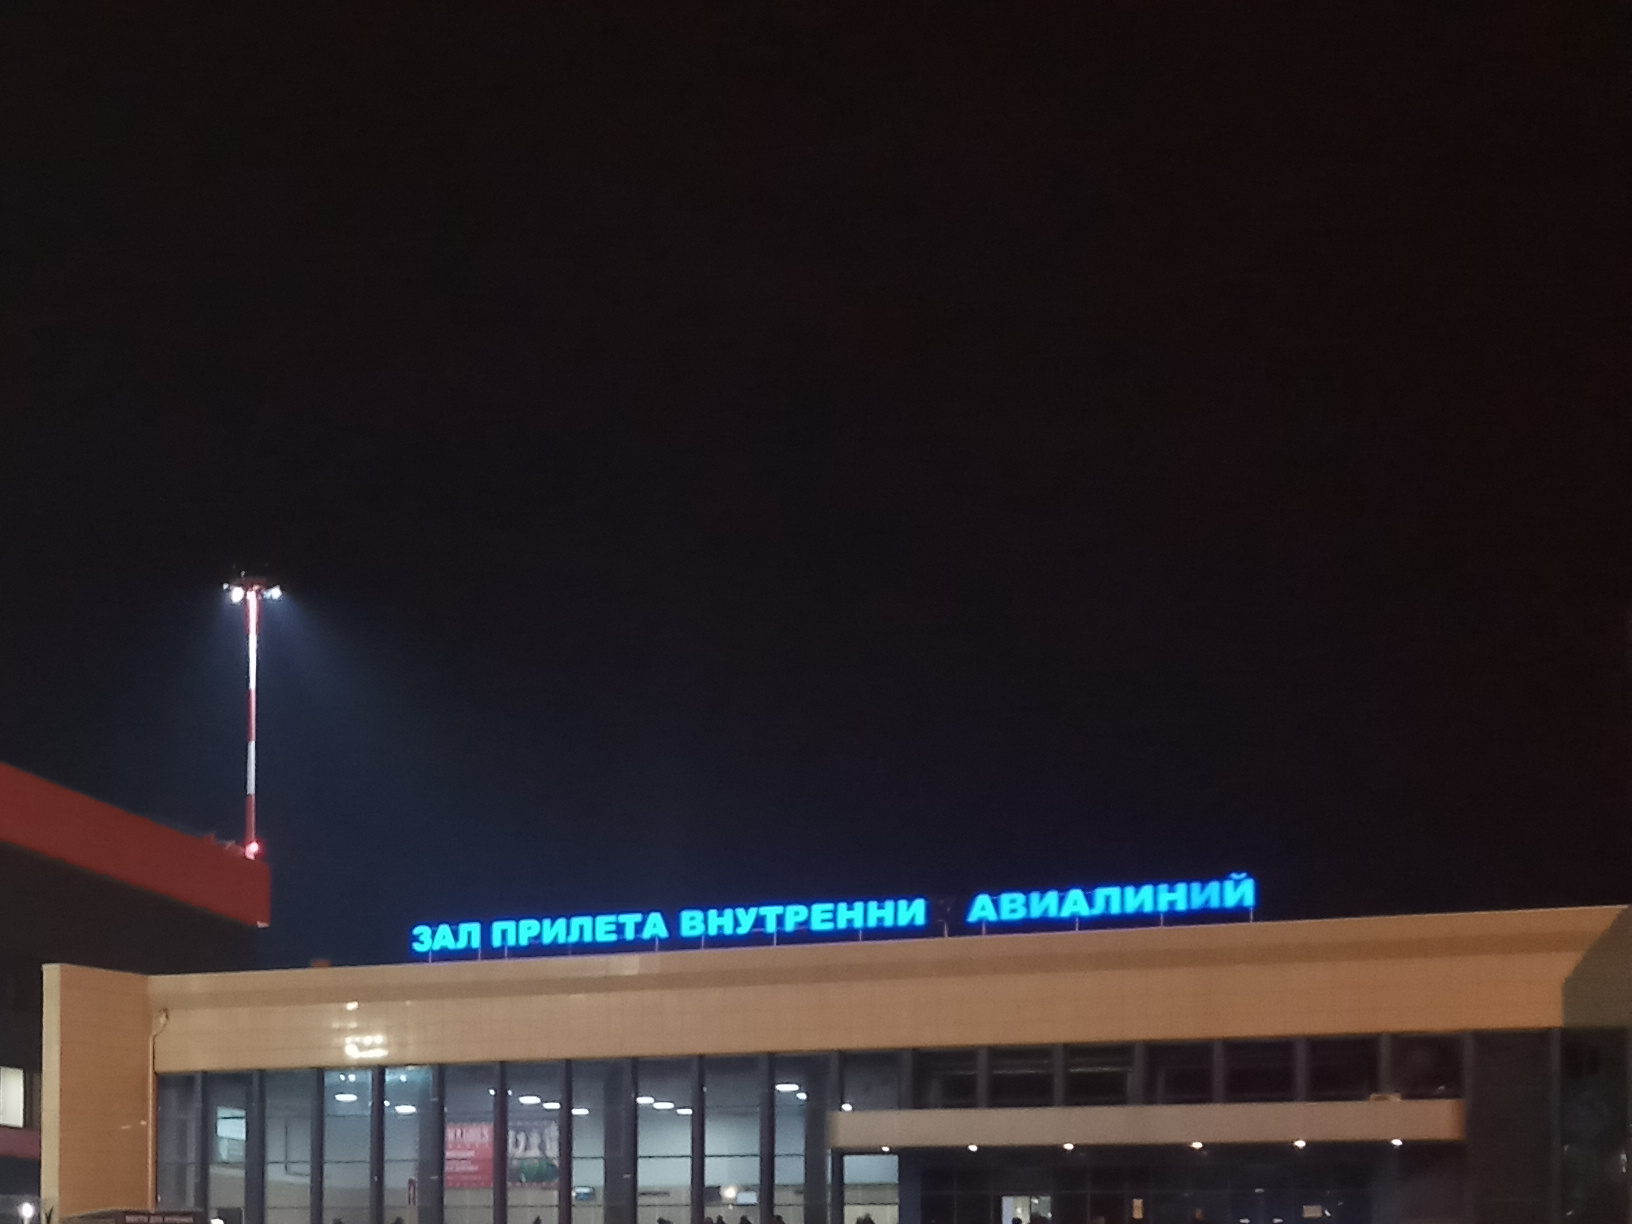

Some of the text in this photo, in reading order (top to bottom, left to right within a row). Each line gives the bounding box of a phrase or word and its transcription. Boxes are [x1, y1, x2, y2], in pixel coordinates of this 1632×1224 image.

[411, 920, 482, 955] ЗАЛ
[490, 910, 670, 949] ПРИЛЕТА
[966, 872, 1256, 924] АВИАЛИНИЙ
